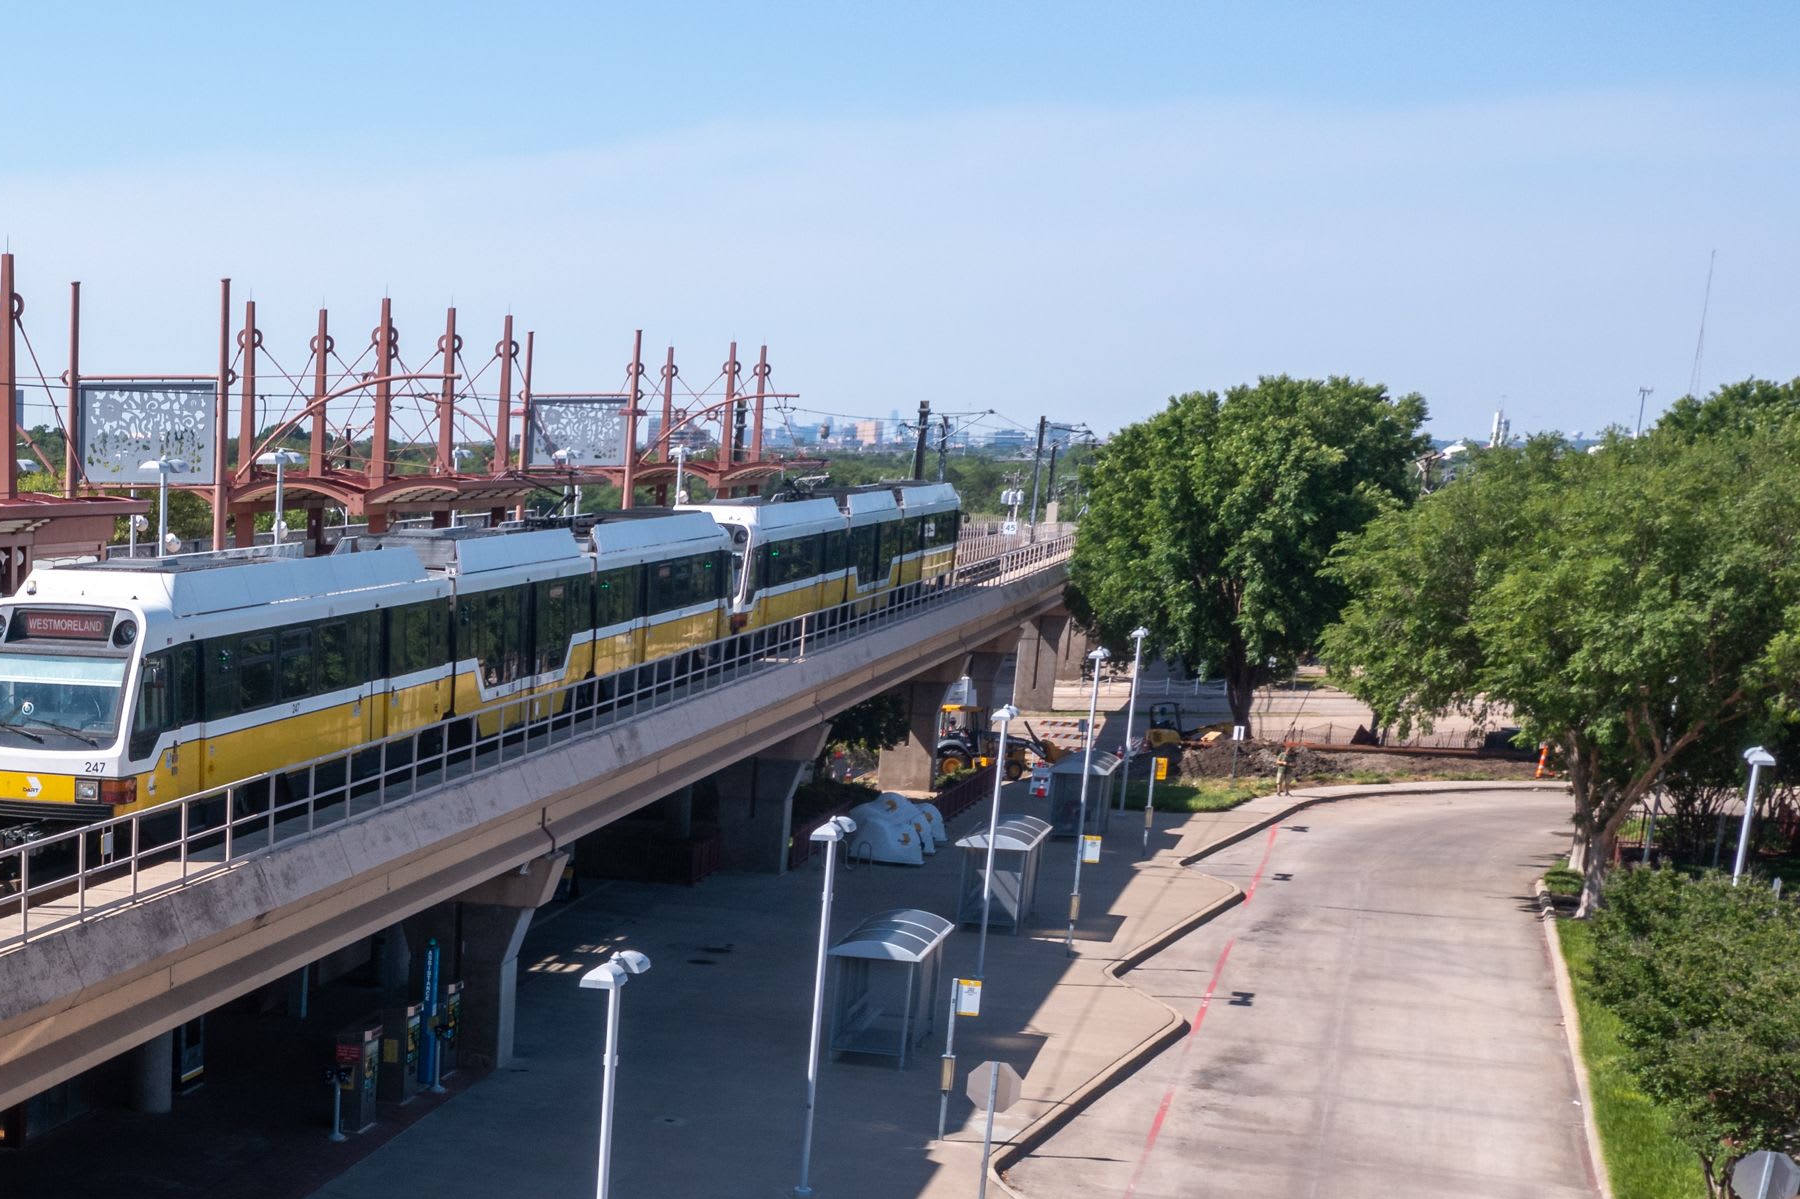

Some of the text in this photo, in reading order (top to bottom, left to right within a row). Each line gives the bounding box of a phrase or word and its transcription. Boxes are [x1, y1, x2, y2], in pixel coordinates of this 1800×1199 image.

[28, 617, 102, 632] WESTMORELAND
[85, 762, 106, 773] 247
[425, 950, 433, 1001] ASSISTANCE
